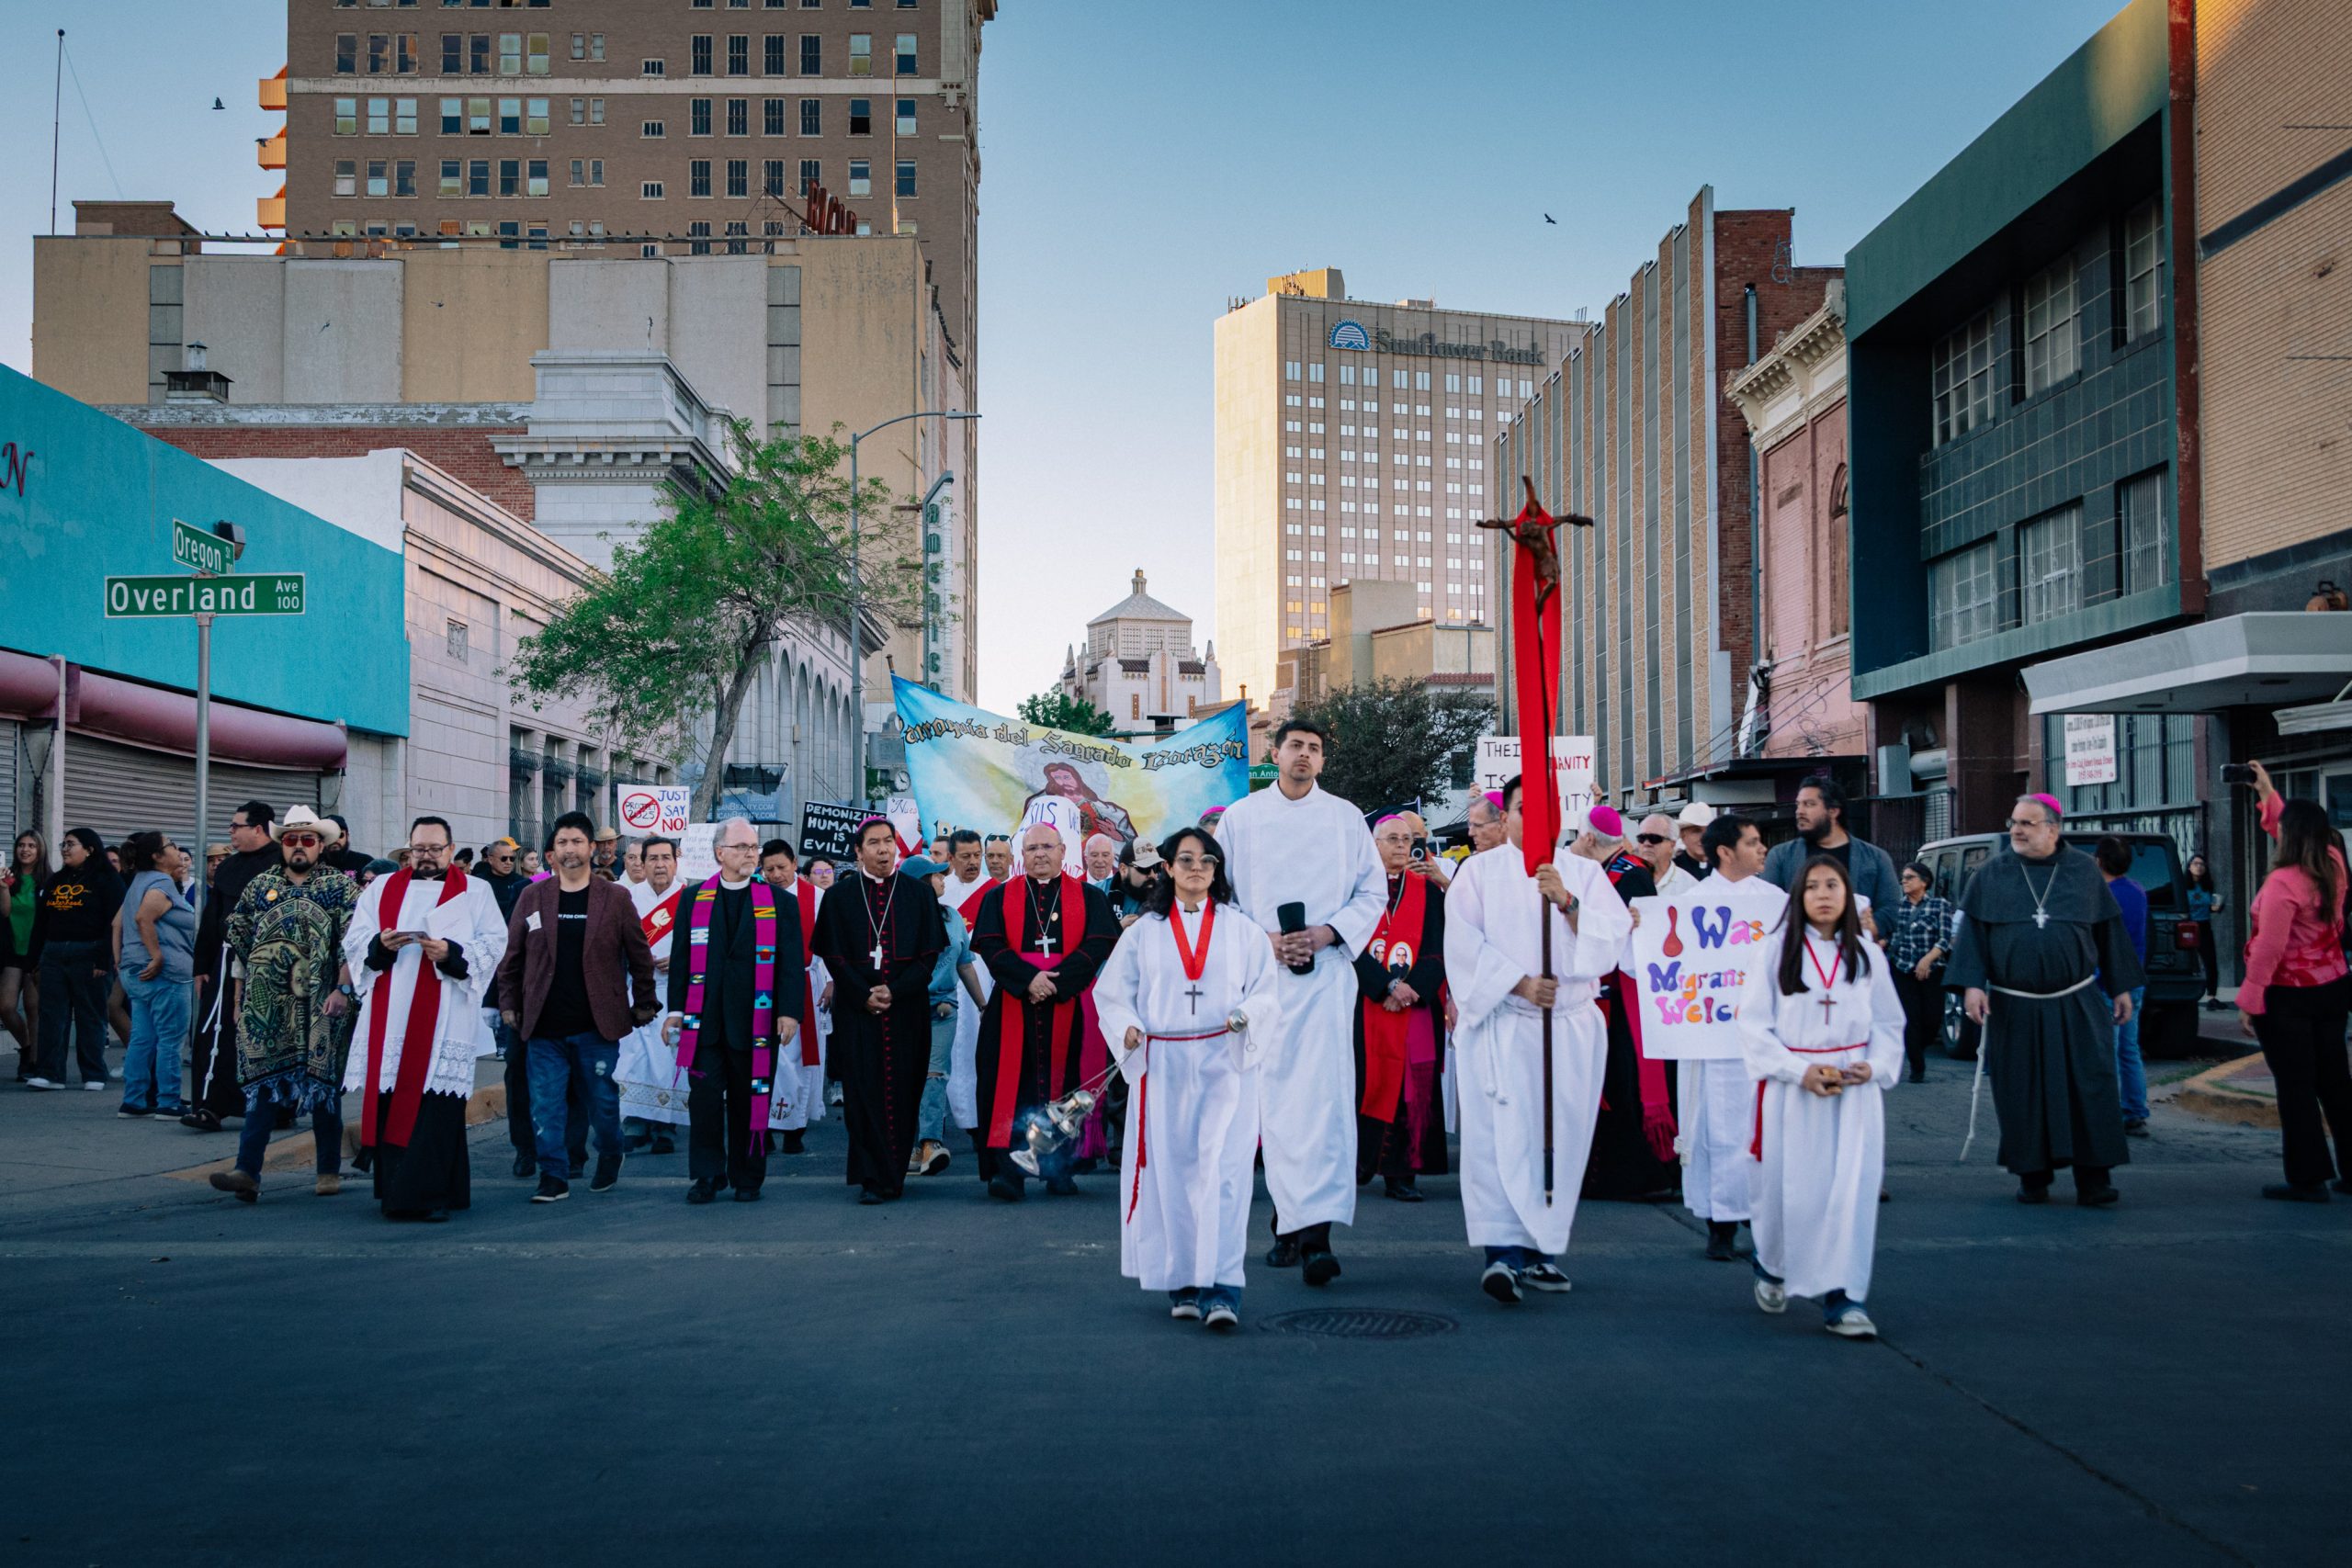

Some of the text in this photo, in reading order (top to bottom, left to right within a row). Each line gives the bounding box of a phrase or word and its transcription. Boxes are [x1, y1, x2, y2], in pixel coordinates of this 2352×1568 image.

[1377, 330, 1545, 366] Sunflower Bank
[175, 526, 221, 571] Oregon
[111, 580, 299, 612] Overland Ave
[277, 596, 300, 609] 100
[993, 722, 1029, 748] del
[1039, 730, 1132, 770] Sagrado
[1141, 727, 1246, 772] Corazón
[1483, 740, 1521, 757] THEI
[1261, 770, 1279, 778] Anto
[1485, 773, 1507, 789] IS
[657, 790, 688, 801] JUST
[664, 805, 685, 817] SAY
[662, 818, 687, 832] NO!
[833, 832, 845, 841] IS
[804, 839, 849, 855] EVIL!
[1663, 906, 1764, 957] I Was
[1656, 996, 1739, 1025] Welc
